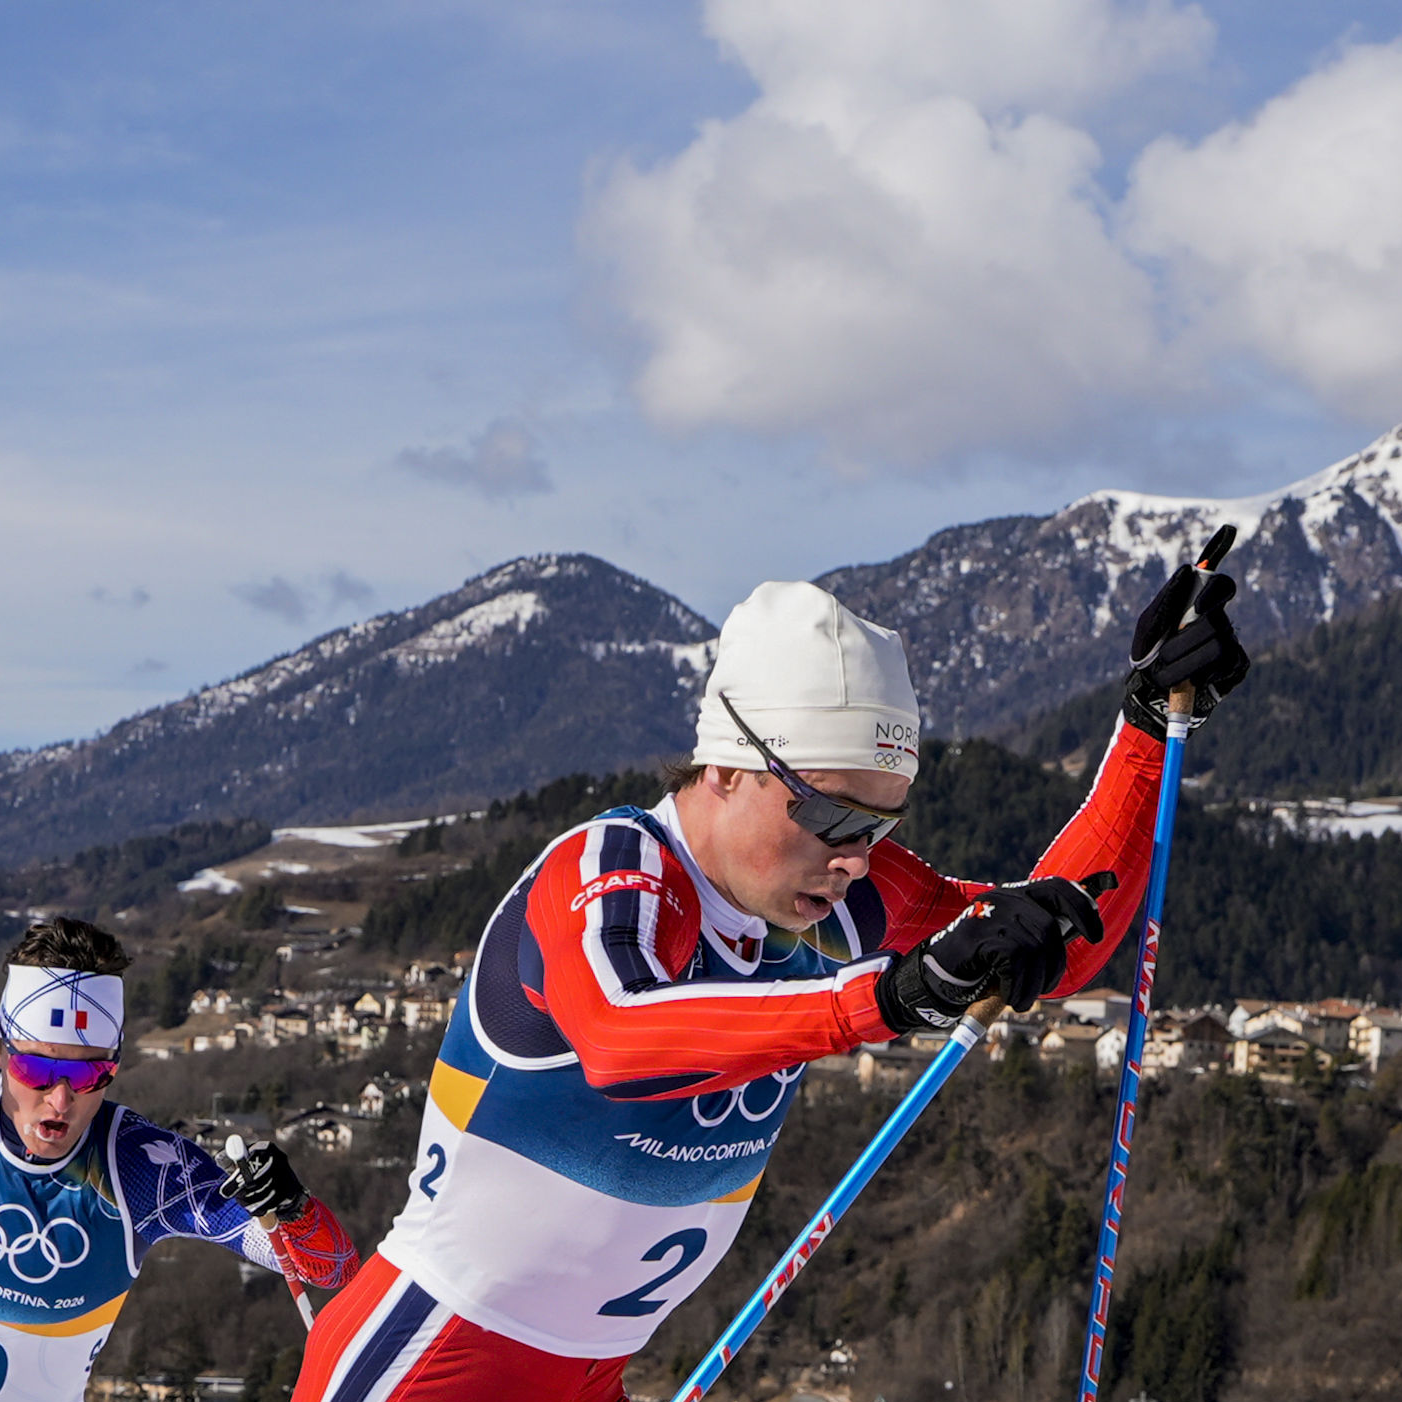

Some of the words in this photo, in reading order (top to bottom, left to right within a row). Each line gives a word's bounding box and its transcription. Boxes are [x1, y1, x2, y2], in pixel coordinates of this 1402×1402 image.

[737, 737, 777, 748] CFT
[876, 722, 919, 749] NORG
[570, 873, 663, 912] CRAFT
[613, 1131, 704, 1163] MILANO
[703, 1138, 766, 1162] CORTINA
[419, 1143, 447, 1202] 2
[597, 1227, 708, 1316] 2
[54, 1296, 85, 1310] 2026
